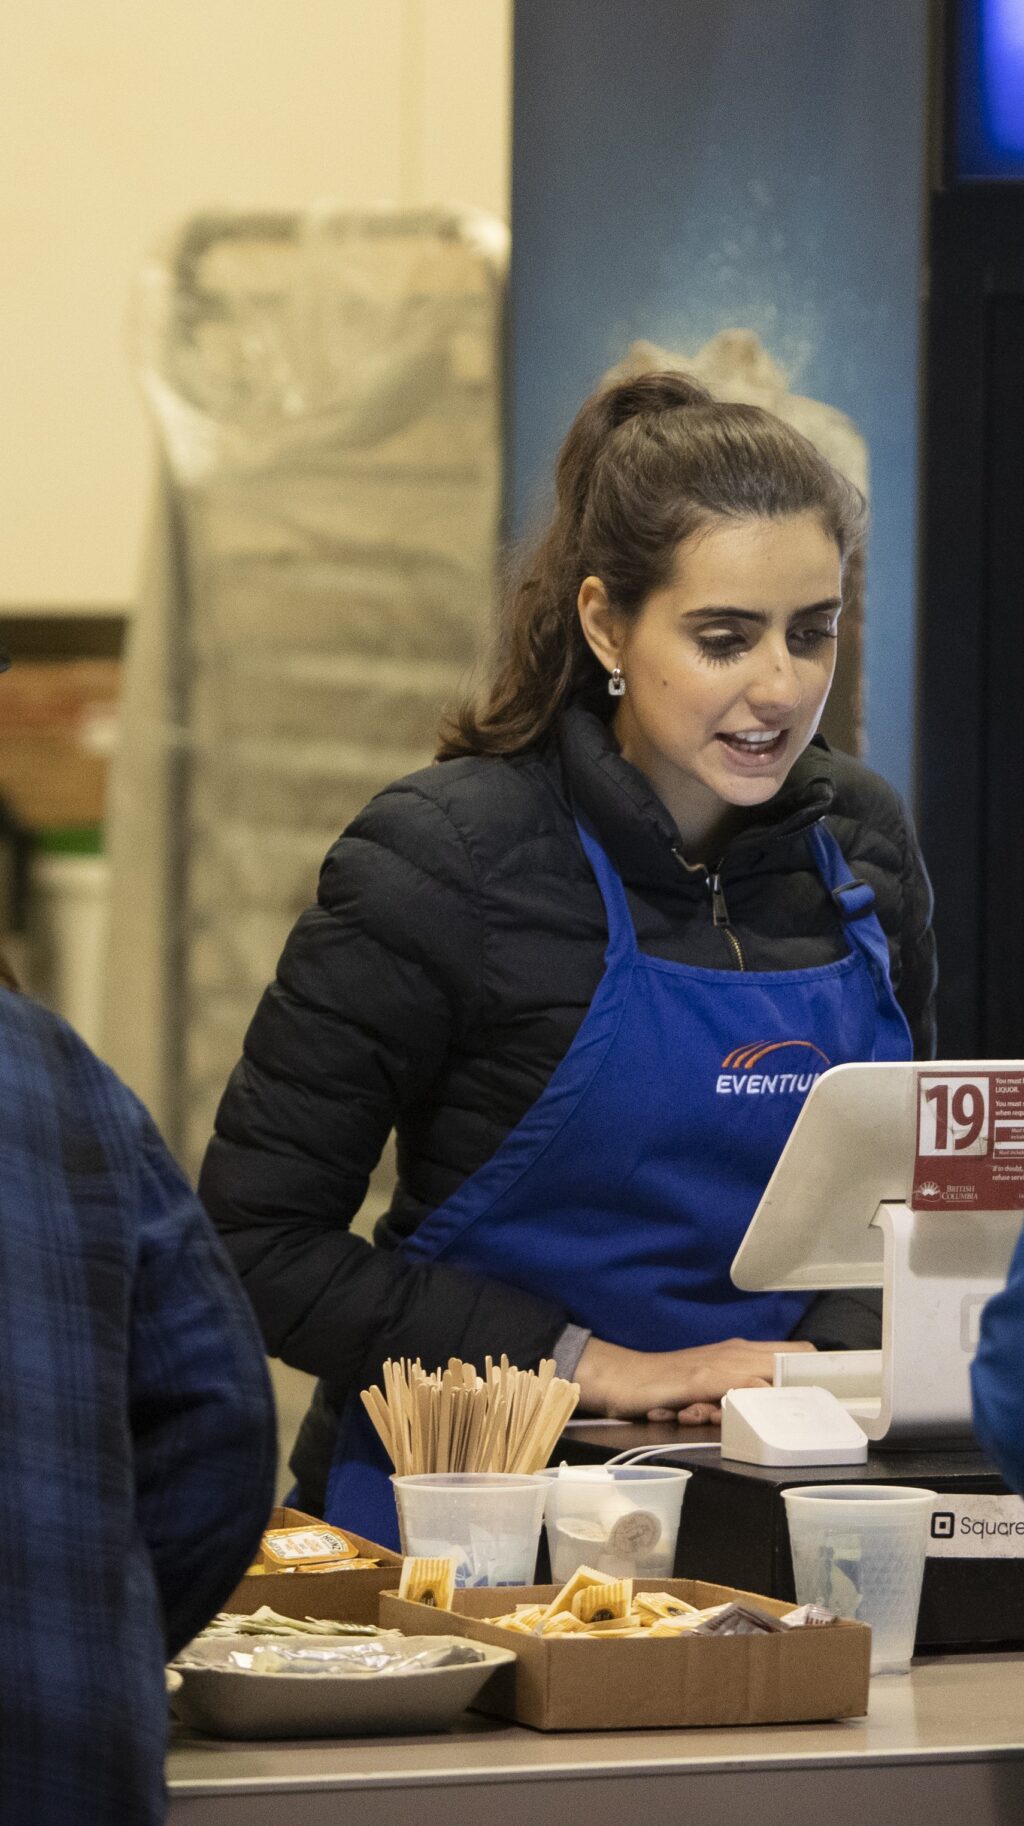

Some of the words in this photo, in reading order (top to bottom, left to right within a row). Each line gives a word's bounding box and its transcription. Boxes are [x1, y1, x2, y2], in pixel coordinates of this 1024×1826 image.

[925, 1084, 984, 1151] 19
[946, 1185, 975, 1193] BRITISH
[941, 1192, 978, 1200] COLUMBIA
